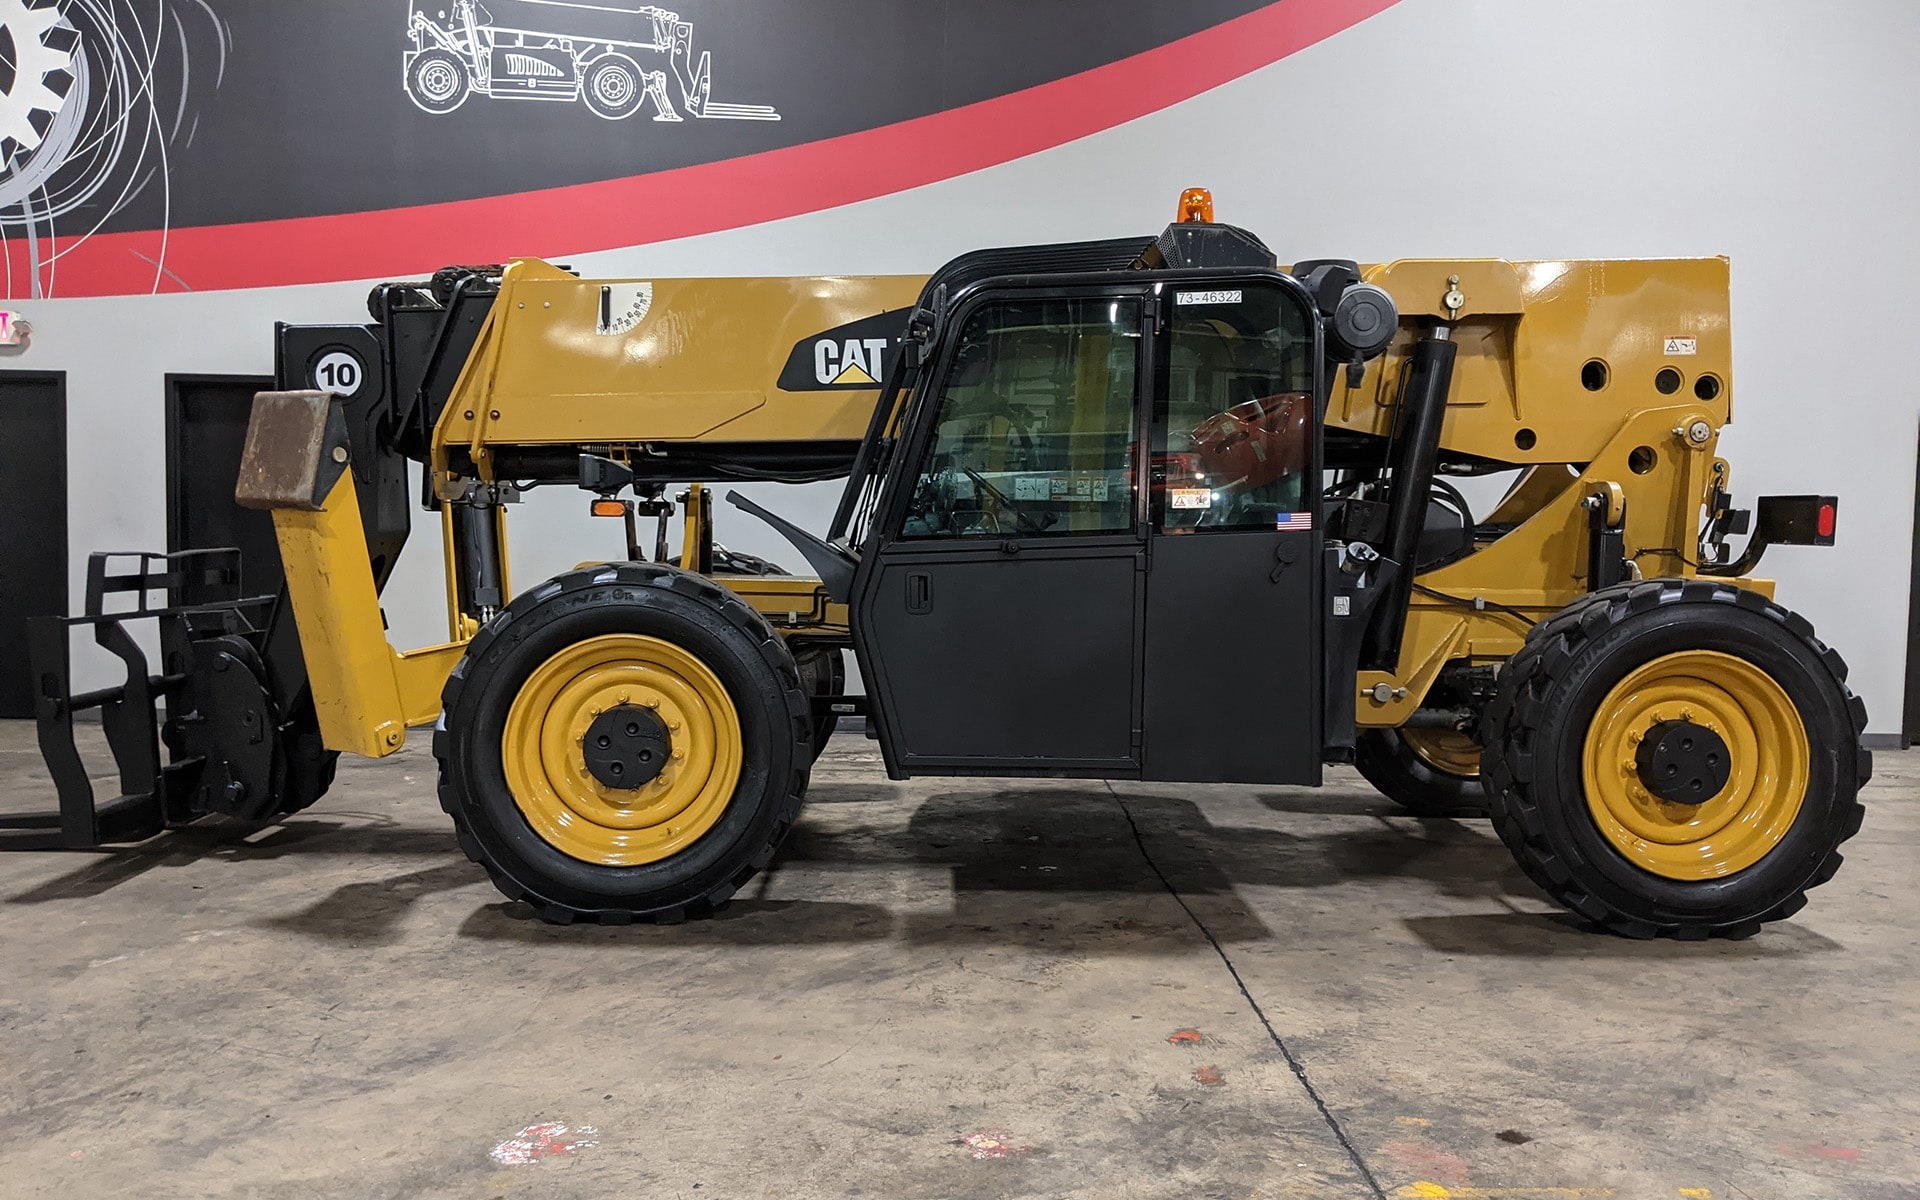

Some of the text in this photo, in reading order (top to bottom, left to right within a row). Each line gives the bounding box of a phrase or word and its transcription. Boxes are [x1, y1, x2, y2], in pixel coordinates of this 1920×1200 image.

[1178, 291, 1241, 304] 73-46322
[814, 338, 888, 385] CAT
[320, 362, 356, 387] 10
